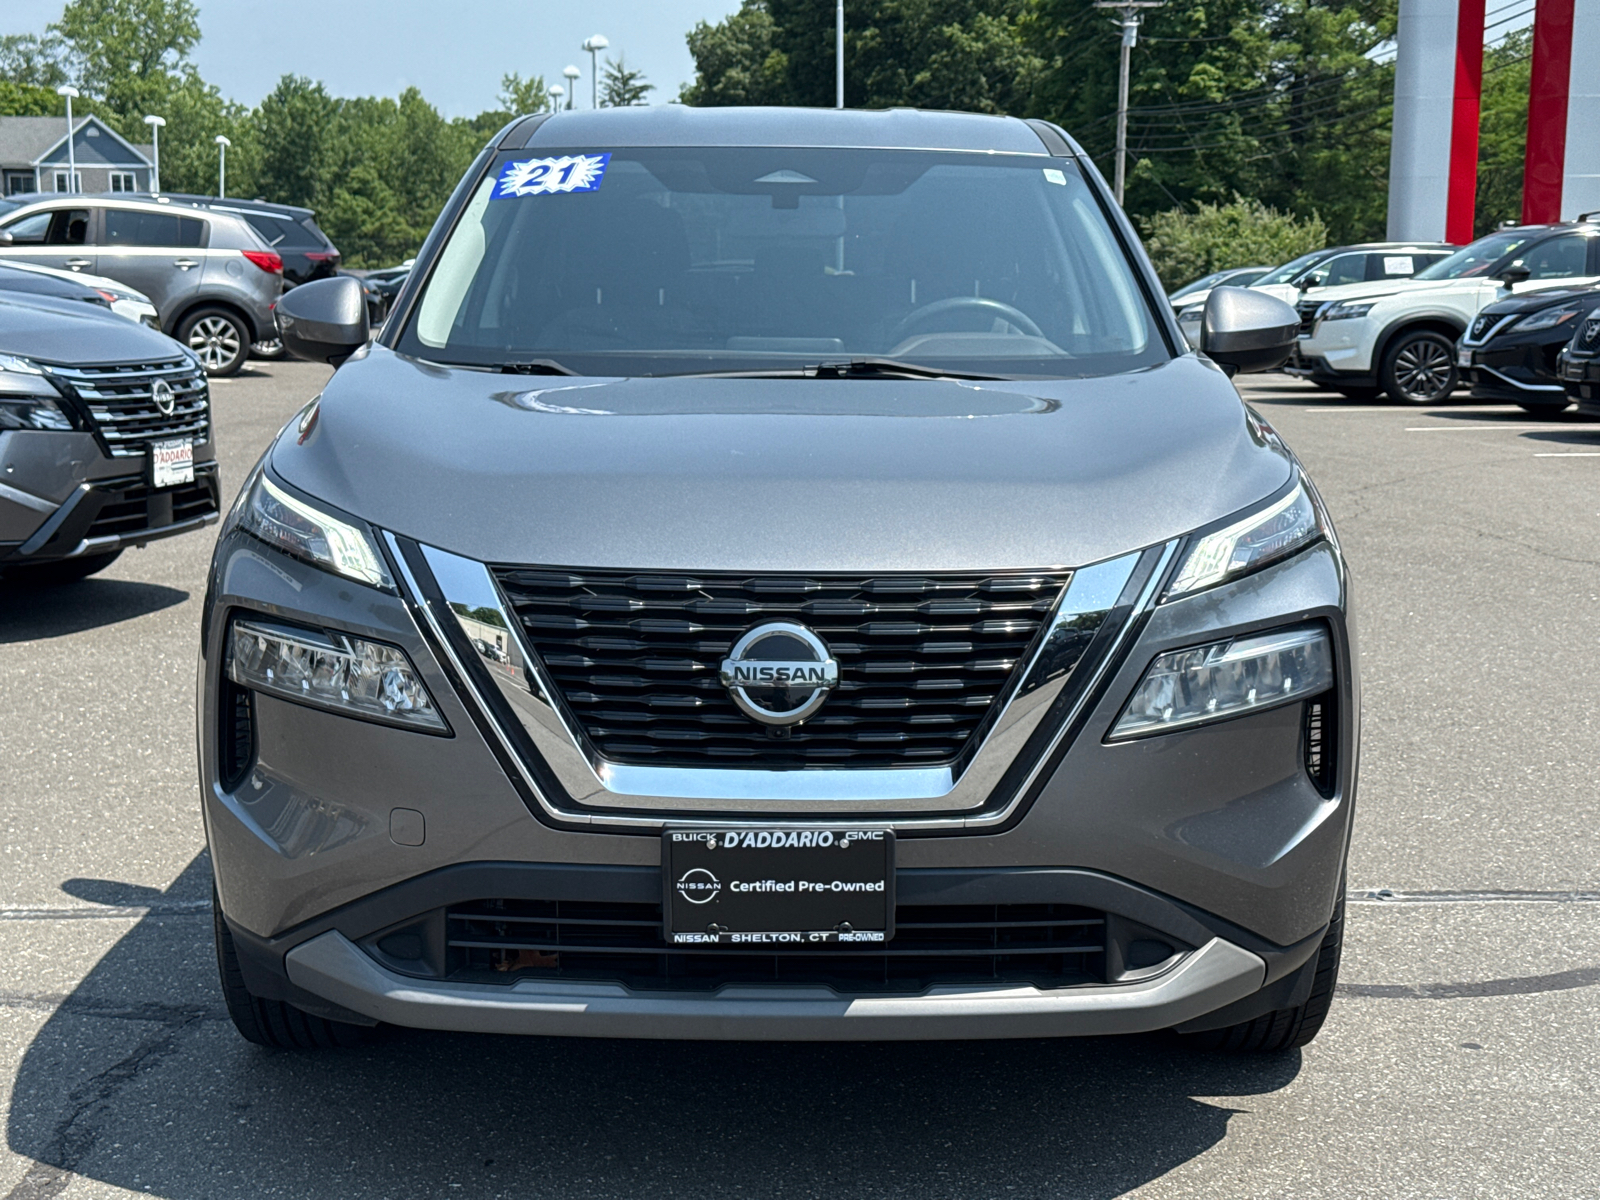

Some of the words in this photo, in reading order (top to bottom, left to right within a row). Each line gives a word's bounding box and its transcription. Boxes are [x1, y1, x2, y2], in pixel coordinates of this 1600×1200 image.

[519, 162, 579, 188] 21
[153, 449, 193, 464] D'ADDARIO
[734, 666, 825, 682] NISSAN
[672, 833, 717, 842] BUICK
[723, 831, 834, 848] D'ADDARIO
[845, 831, 884, 840] GMC
[676, 882, 722, 890] NISSAN
[729, 880, 795, 892] Certified
[799, 880, 885, 892] Pre-Owned
[674, 934, 720, 943] NISSAN
[731, 933, 805, 943] SHELTON,
[809, 933, 830, 942] CT
[838, 933, 885, 942] PRE-OWNED
